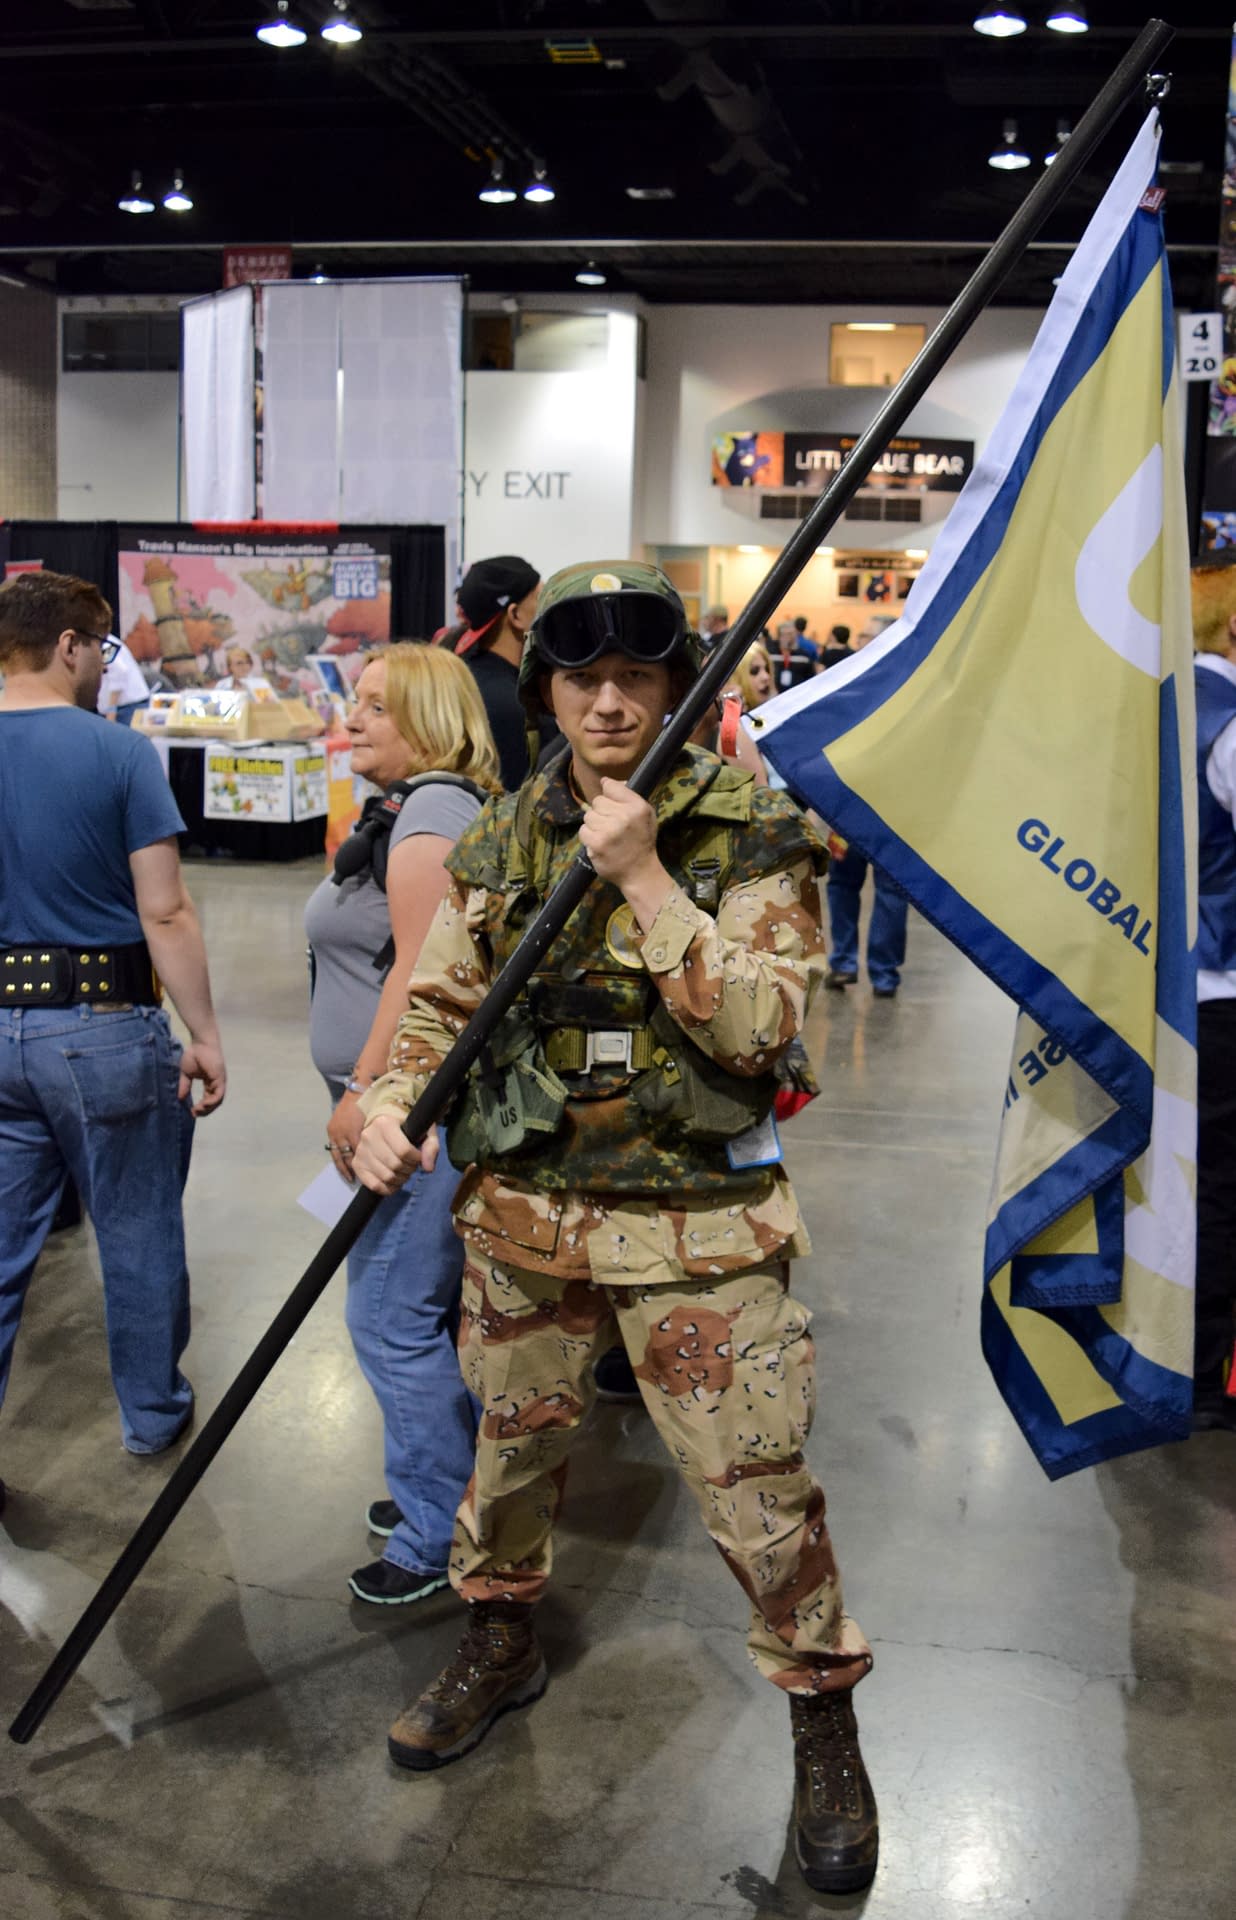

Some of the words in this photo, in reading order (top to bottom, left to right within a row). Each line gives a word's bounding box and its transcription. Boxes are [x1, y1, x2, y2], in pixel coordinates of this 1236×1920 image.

[1192, 319, 1209, 340] 4
[1186, 357, 1217, 373] 20
[795, 450, 850, 471] LITTL
[871, 452, 911, 473] LUE
[913, 453, 966, 476] BEAR
[504, 470, 571, 499] EXIT
[335, 580, 377, 598] BIG
[1016, 818, 1153, 957] GLOBAL
[500, 1106, 518, 1129] US
